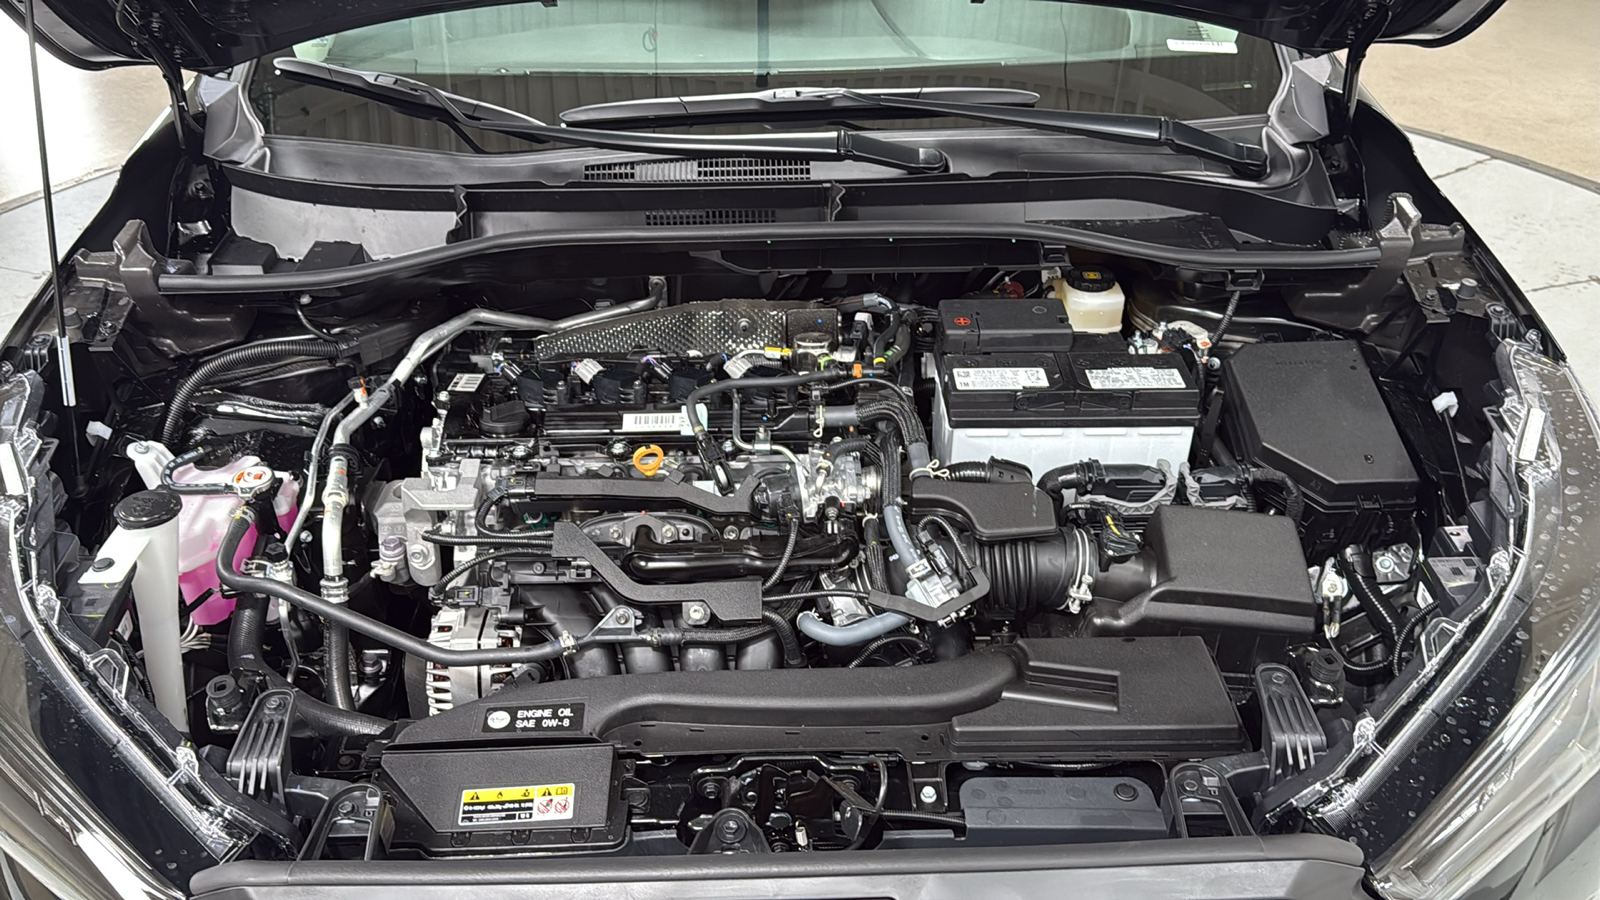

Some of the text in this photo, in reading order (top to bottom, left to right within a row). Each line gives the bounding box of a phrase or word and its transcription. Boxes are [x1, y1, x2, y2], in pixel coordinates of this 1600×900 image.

[517, 707, 574, 718] ENGINE OIL
[515, 718, 570, 728] SAE 0W-8
